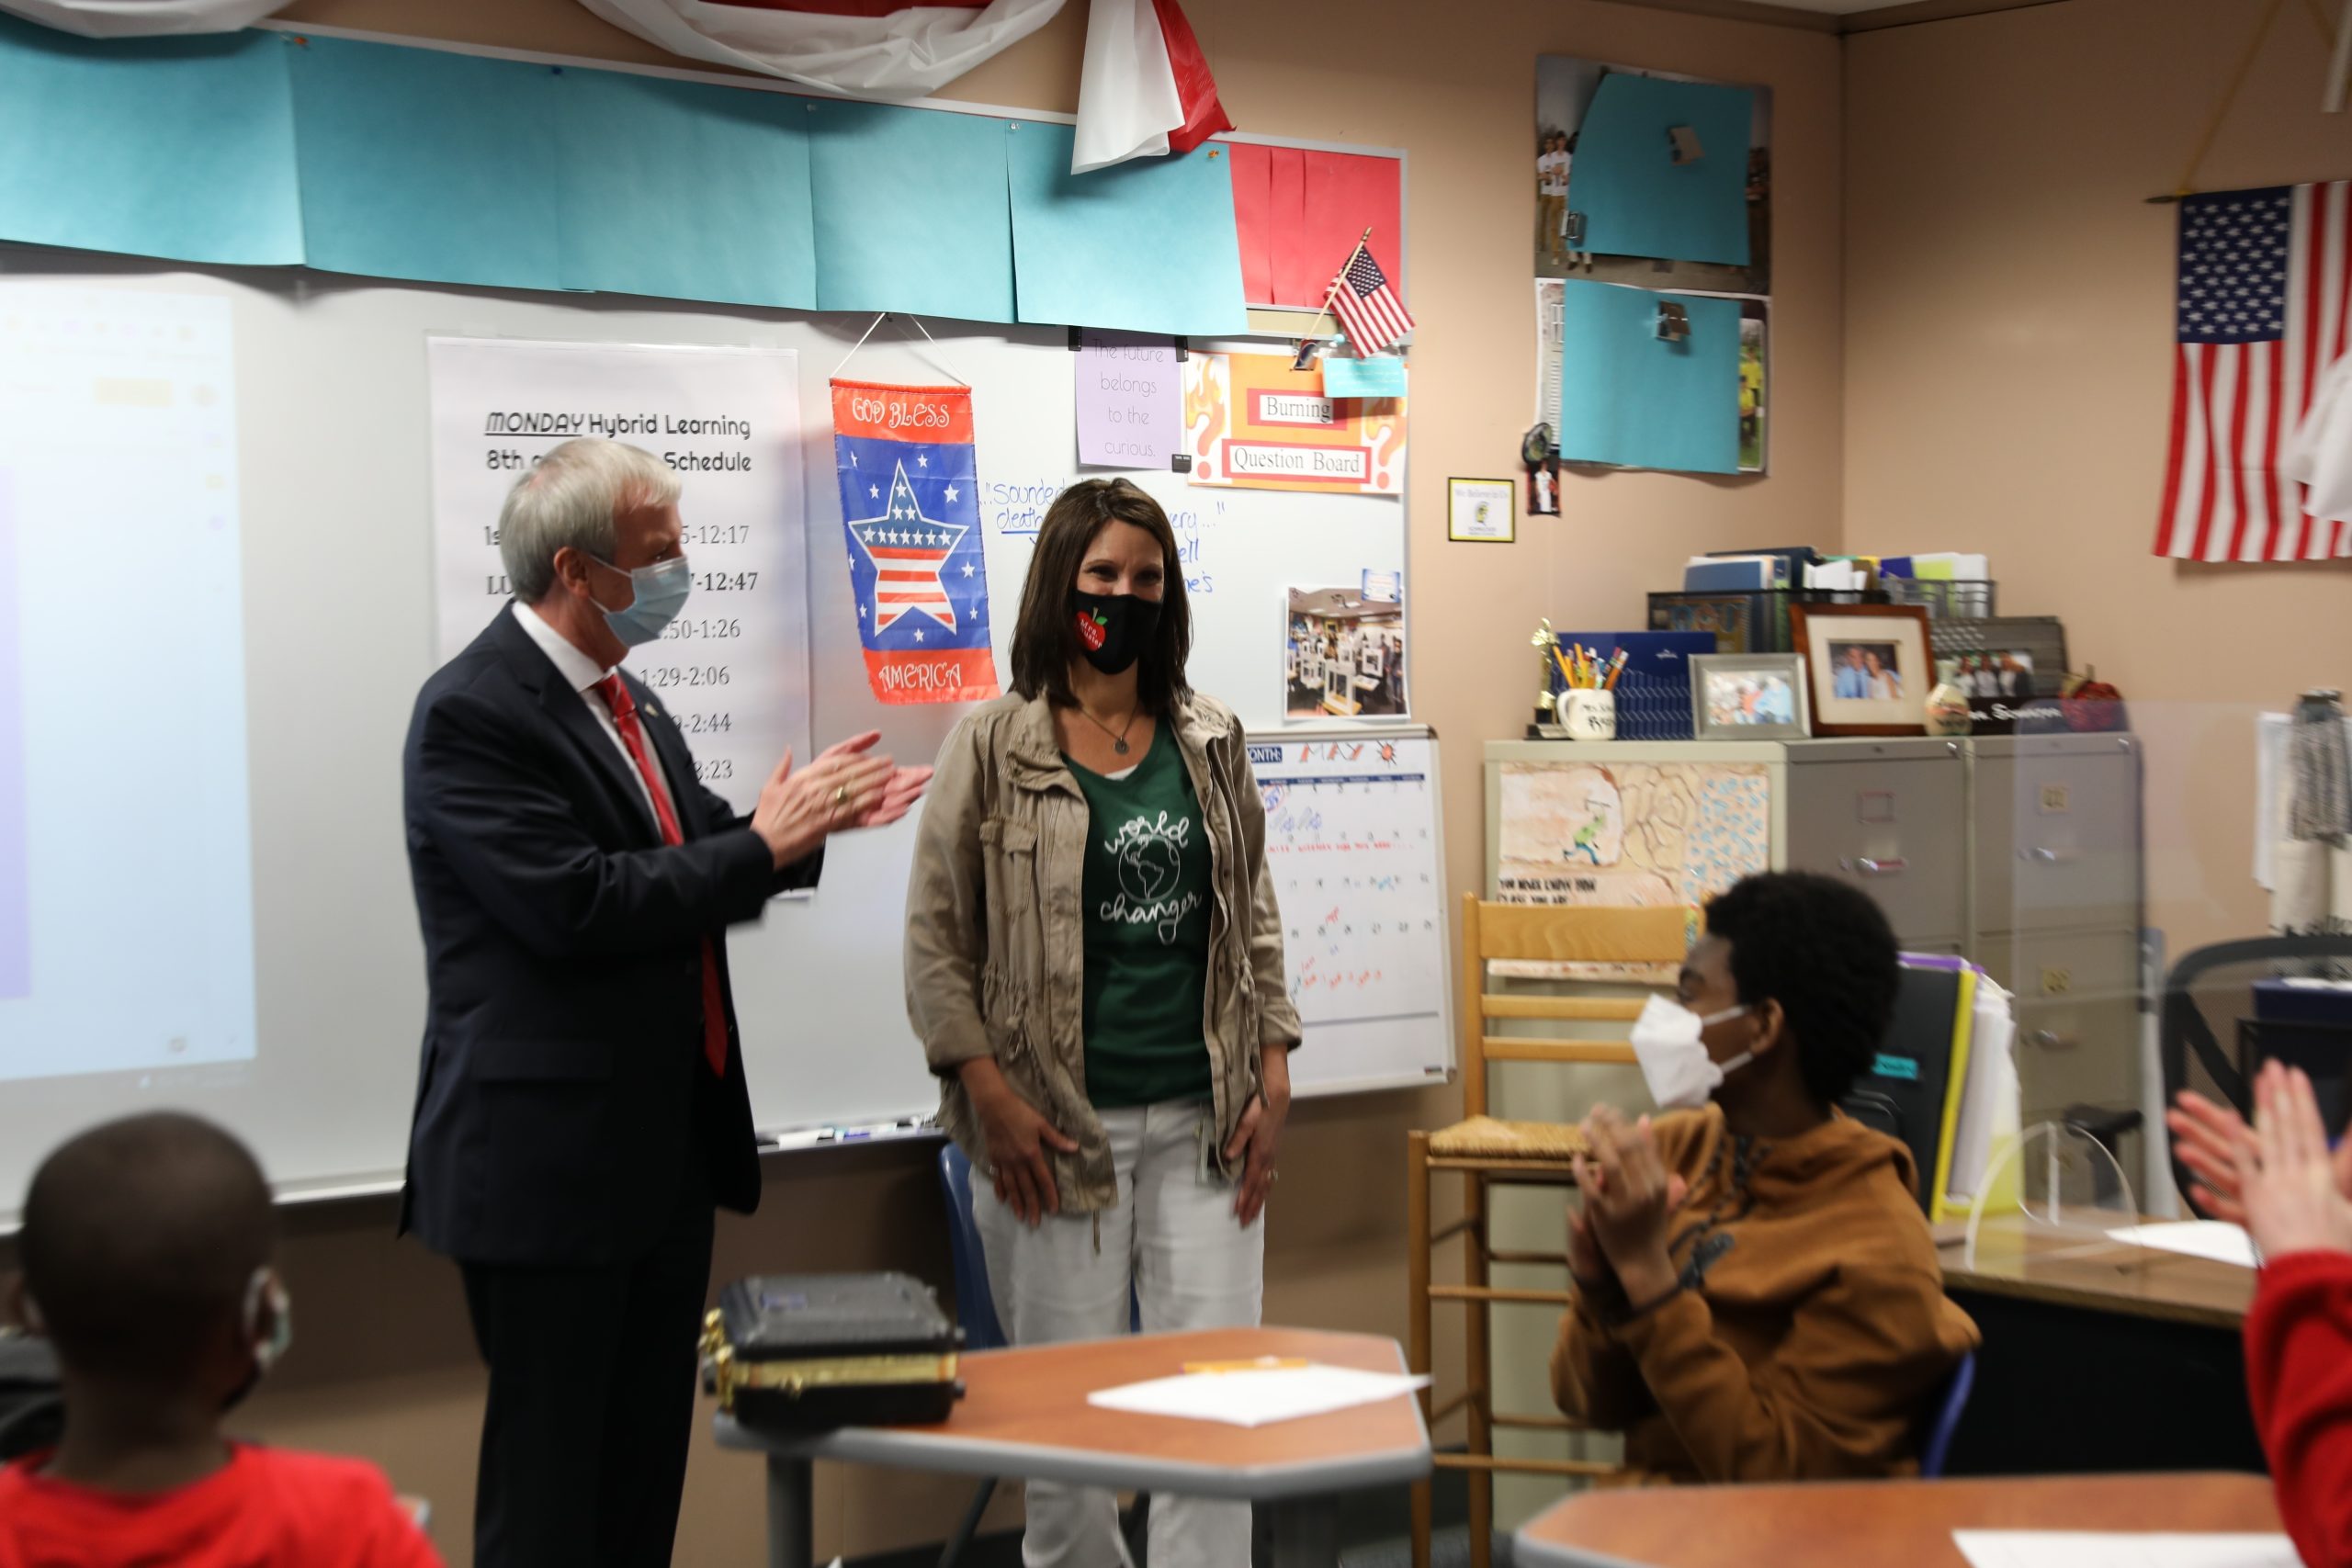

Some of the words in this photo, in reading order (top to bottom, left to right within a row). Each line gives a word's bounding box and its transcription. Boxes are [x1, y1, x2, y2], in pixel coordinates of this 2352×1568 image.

[1093, 338, 1117, 359] The
[1123, 344, 1164, 363] future
[1101, 371, 1158, 398] belongs
[853, 397, 885, 423] GOD
[888, 402, 950, 429] BLESS
[1108, 406, 1123, 423] to
[1127, 406, 1149, 424] the
[1267, 396, 1331, 423] Burning
[485, 412, 584, 434] MONDAY
[589, 413, 658, 439] Hybrid
[665, 414, 751, 441] Learning
[487, 449, 525, 470] 8th
[664, 451, 752, 471] Schedule
[1104, 439, 1156, 457] curious.
[1235, 447, 1305, 471] Question
[1313, 451, 1360, 473] Board
[996, 507, 1044, 530] death
[679, 525, 750, 545] 5-12:17
[1178, 537, 1199, 564] ell
[878, 661, 962, 694] AMERICA
[672, 712, 732, 734] 9-2:44
[1248, 747, 1283, 763] ONTH:
[694, 759, 734, 782] 3:23
[1103, 809, 1191, 855] world
[1100, 890, 1203, 946] changer
